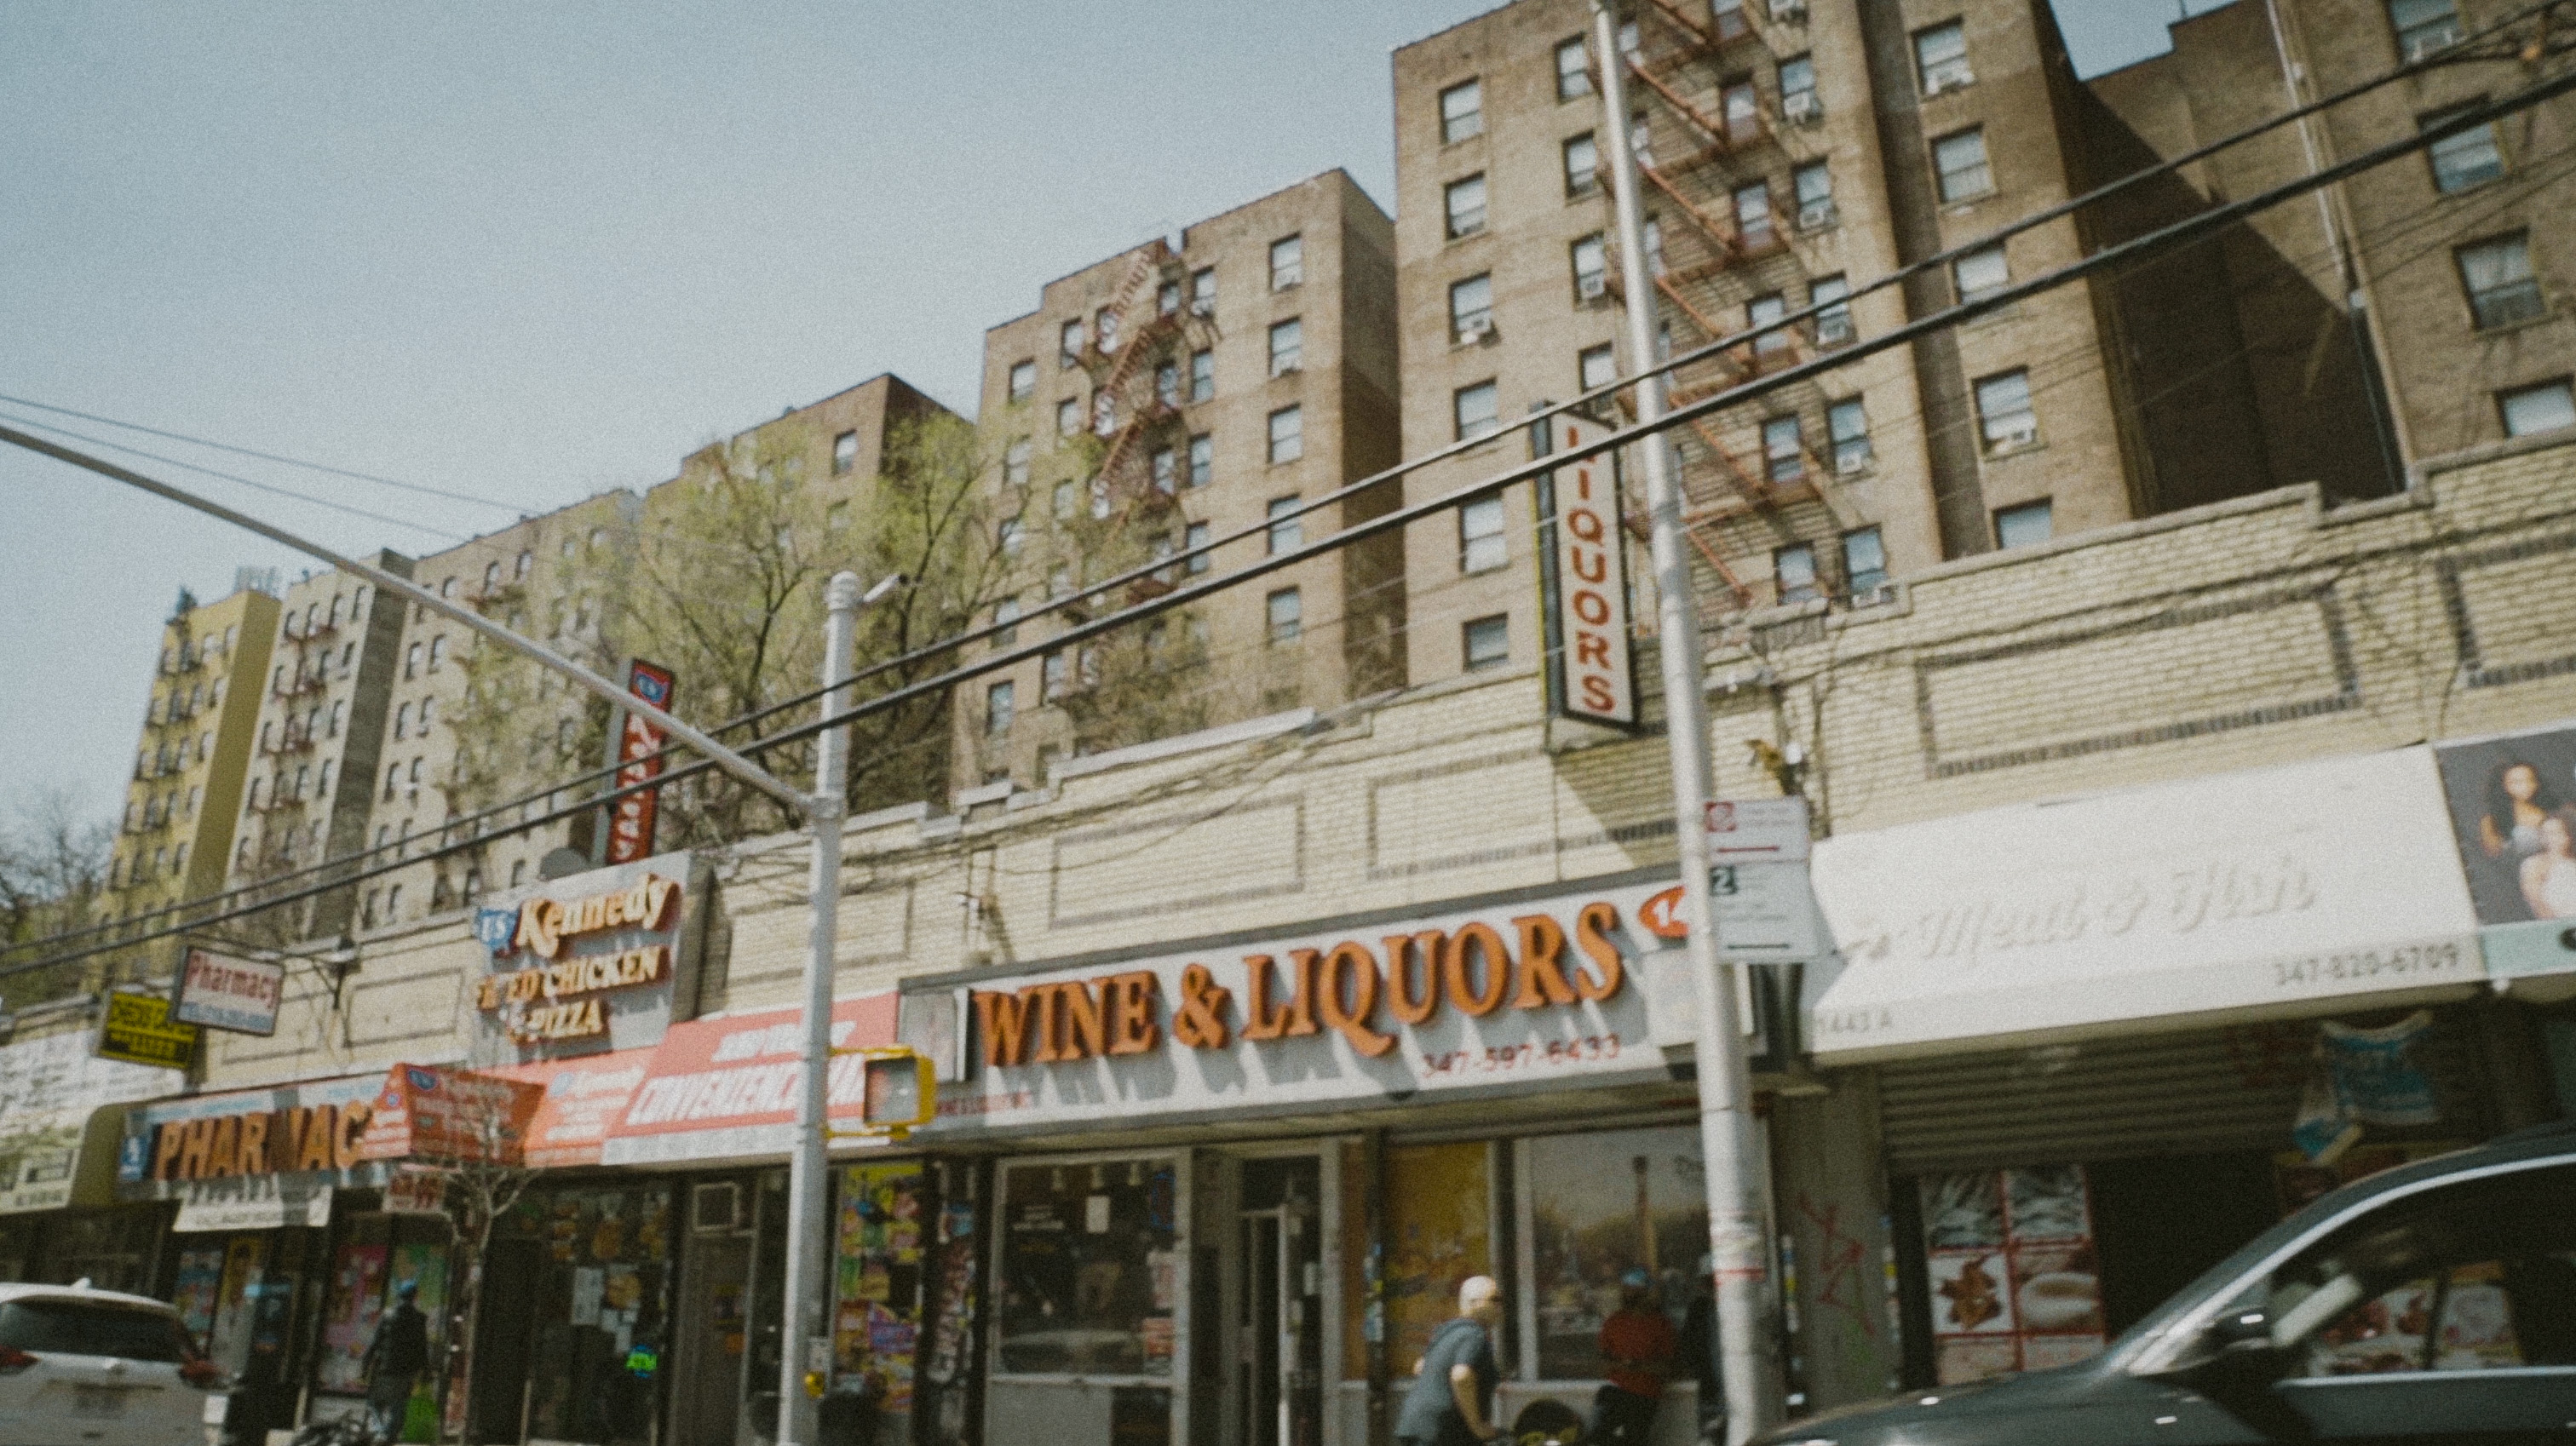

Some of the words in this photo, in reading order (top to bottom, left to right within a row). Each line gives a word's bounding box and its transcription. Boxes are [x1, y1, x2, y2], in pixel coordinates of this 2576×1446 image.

[1714, 869, 1730, 893] 2
[516, 873, 679, 958] Kennedy
[542, 946, 664, 998] CHICKEN
[973, 970, 1160, 1067] WINE
[1172, 963, 1231, 1049] &
[1240, 901, 1625, 1057] LIQUORS
[528, 999, 604, 1040] PIZZA
[154, 1100, 371, 1181] PHARMAC
